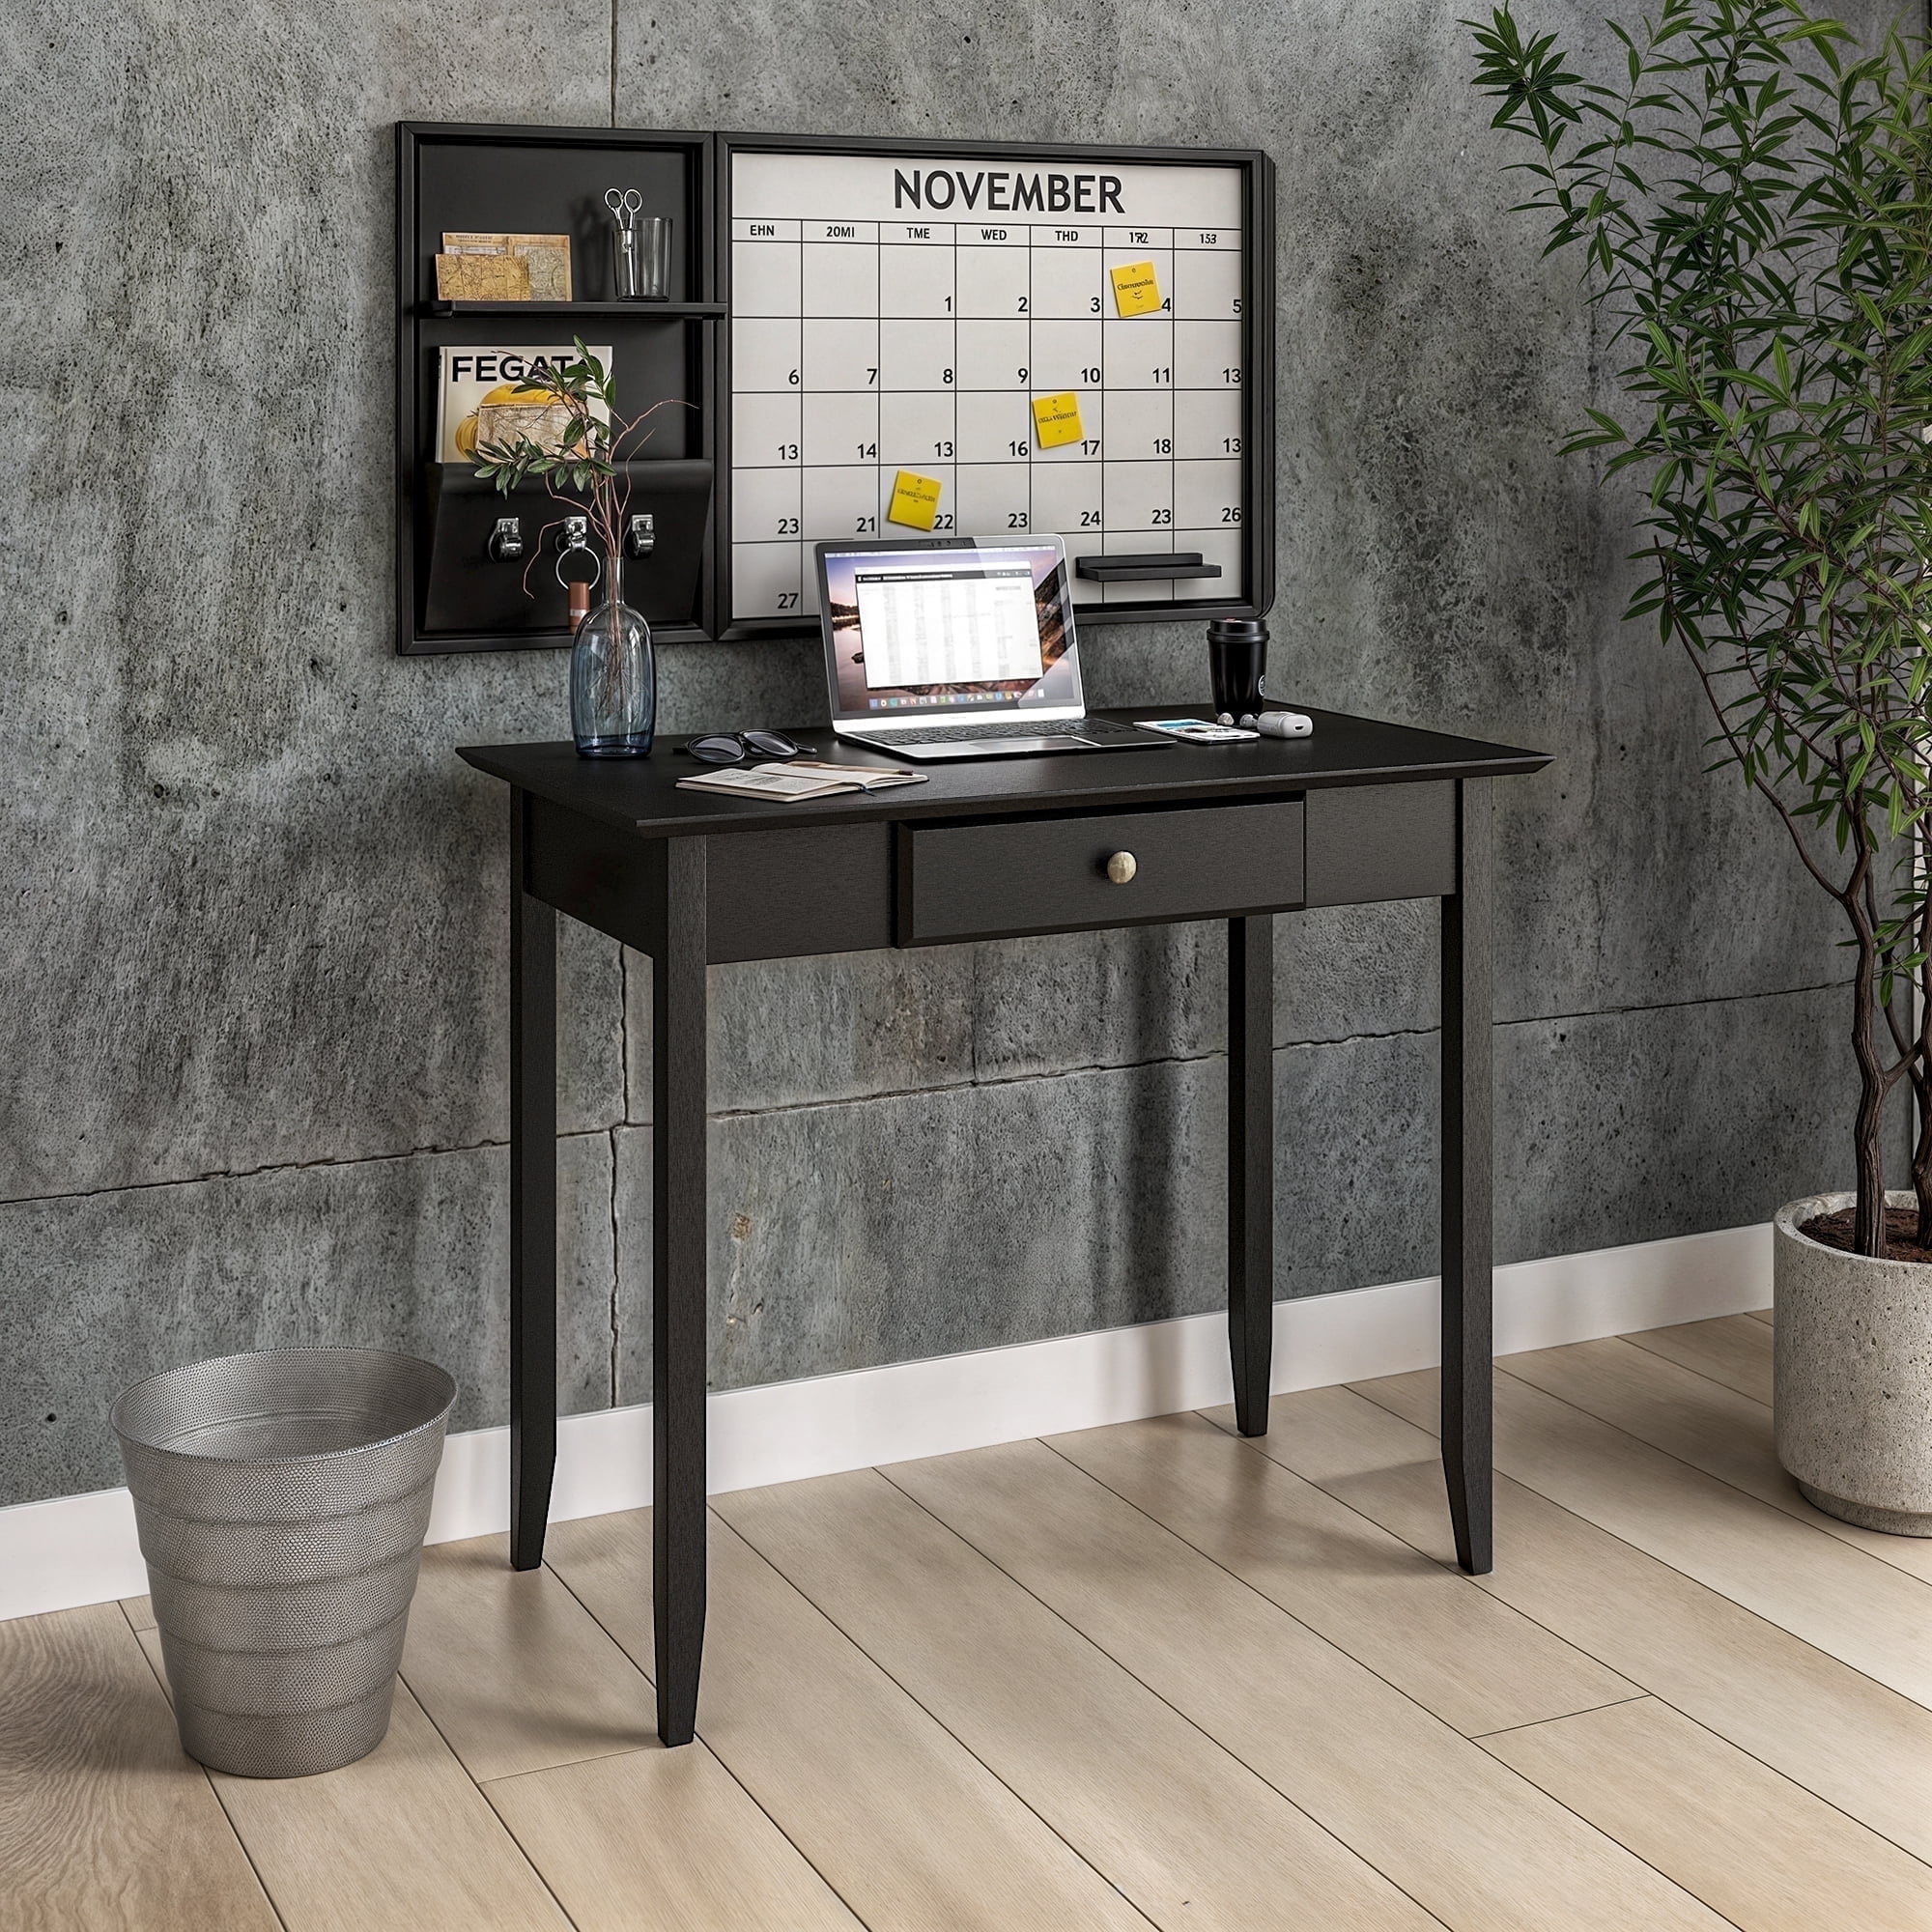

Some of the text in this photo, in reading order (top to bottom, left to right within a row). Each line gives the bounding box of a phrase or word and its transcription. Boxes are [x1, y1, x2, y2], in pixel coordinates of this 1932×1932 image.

[894, 168, 1125, 214] NOVEMBER
[750, 224, 775, 237] EHN
[906, 227, 930, 240] TME
[980, 229, 1008, 241] WED
[1055, 230, 1079, 242] THD
[943, 296, 1243, 314] 1 2 3 4 5
[787, 367, 1242, 385] 6 7 8 9 10 11 13
[778, 437, 1242, 461] 13 14 13 16 17 18 13
[777, 507, 1242, 535] 23 21 22 23 24 23 26
[777, 592, 800, 610] 27
